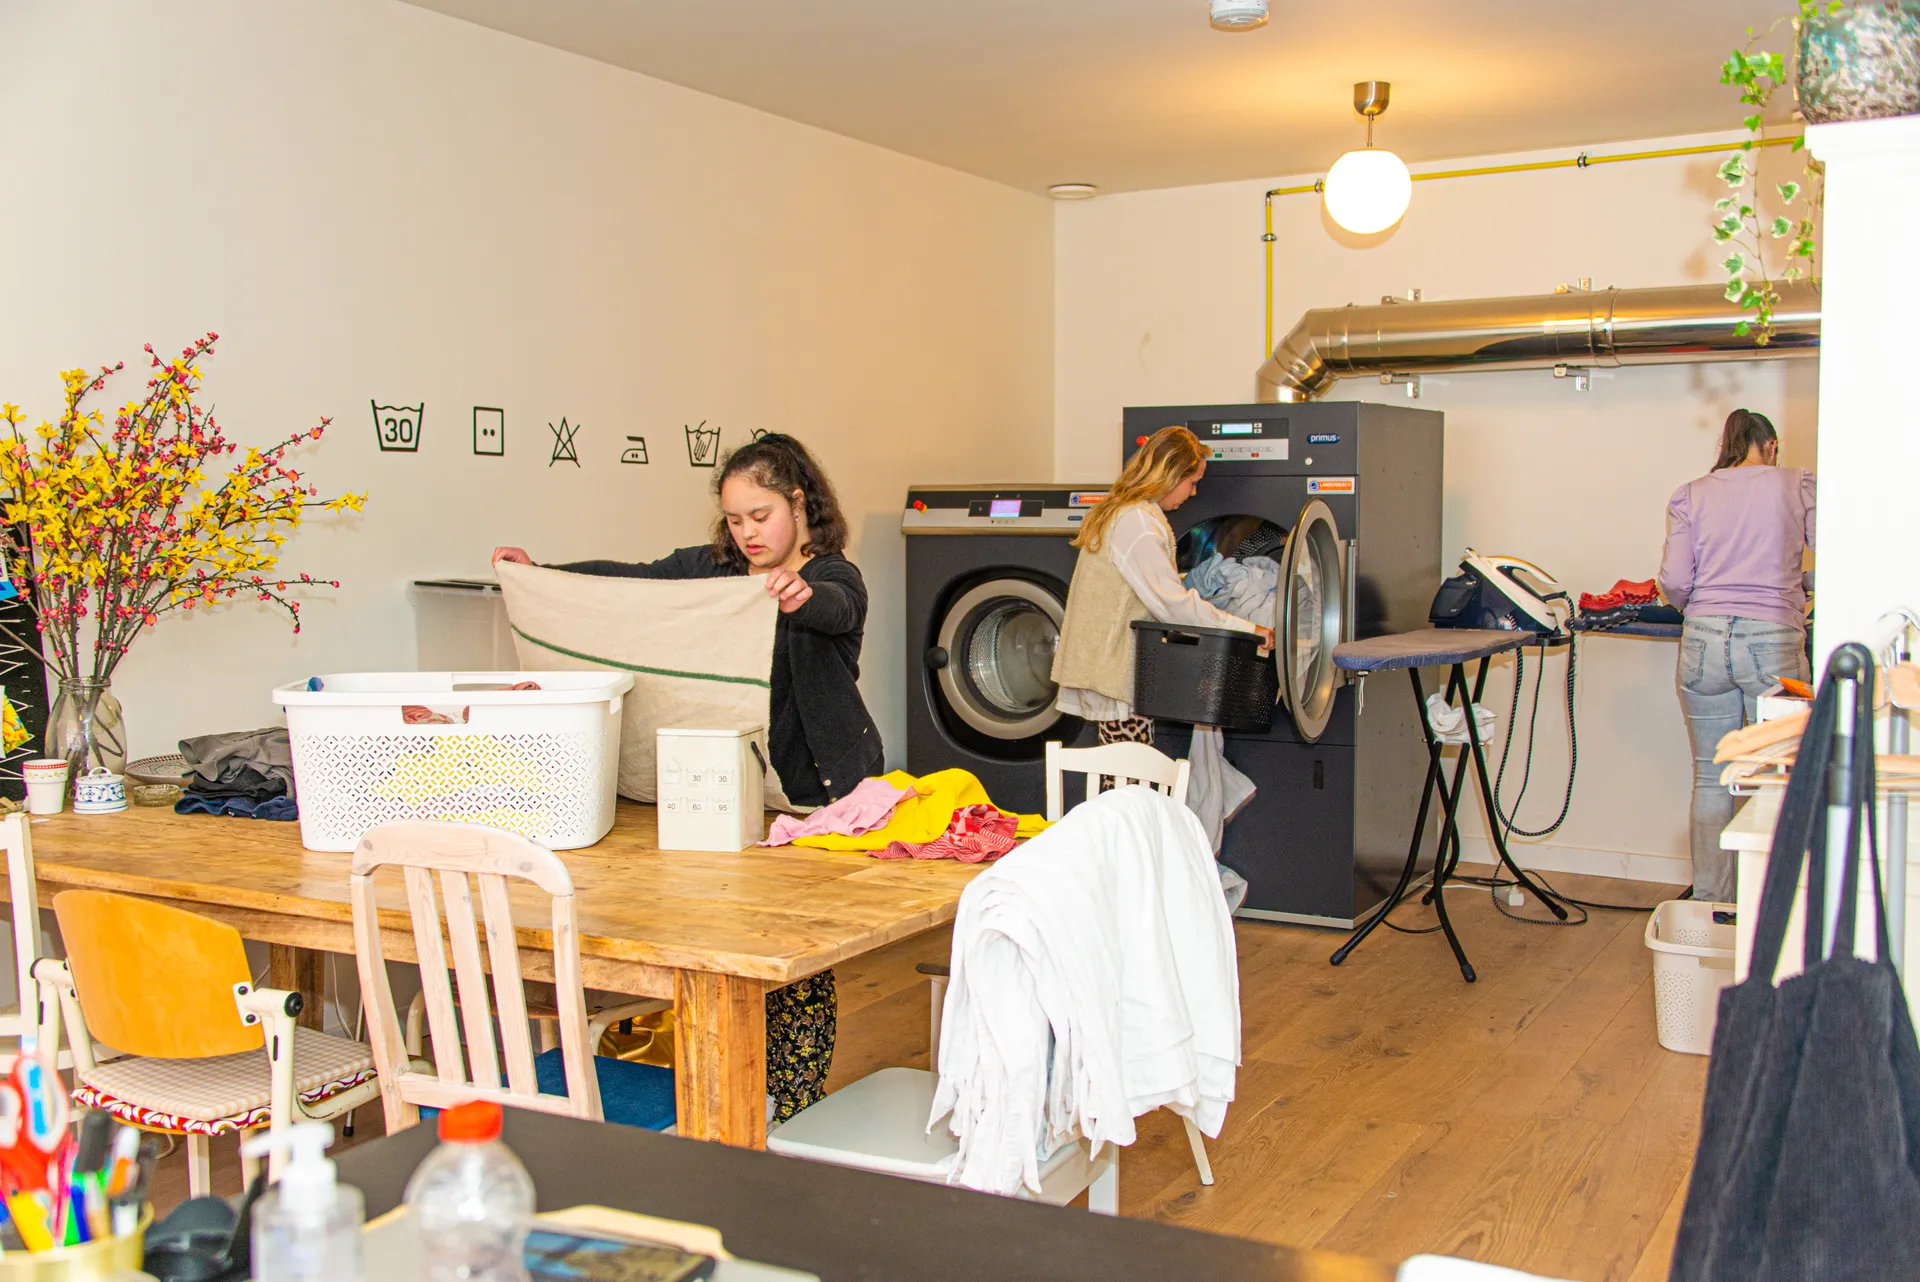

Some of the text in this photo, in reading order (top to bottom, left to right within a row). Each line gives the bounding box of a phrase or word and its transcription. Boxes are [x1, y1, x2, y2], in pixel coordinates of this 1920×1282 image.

[384, 417, 413, 443] 30
[1310, 433, 1337, 443] primus
[692, 774, 728, 783] 30 30
[666, 802, 728, 812] 40 60 95
